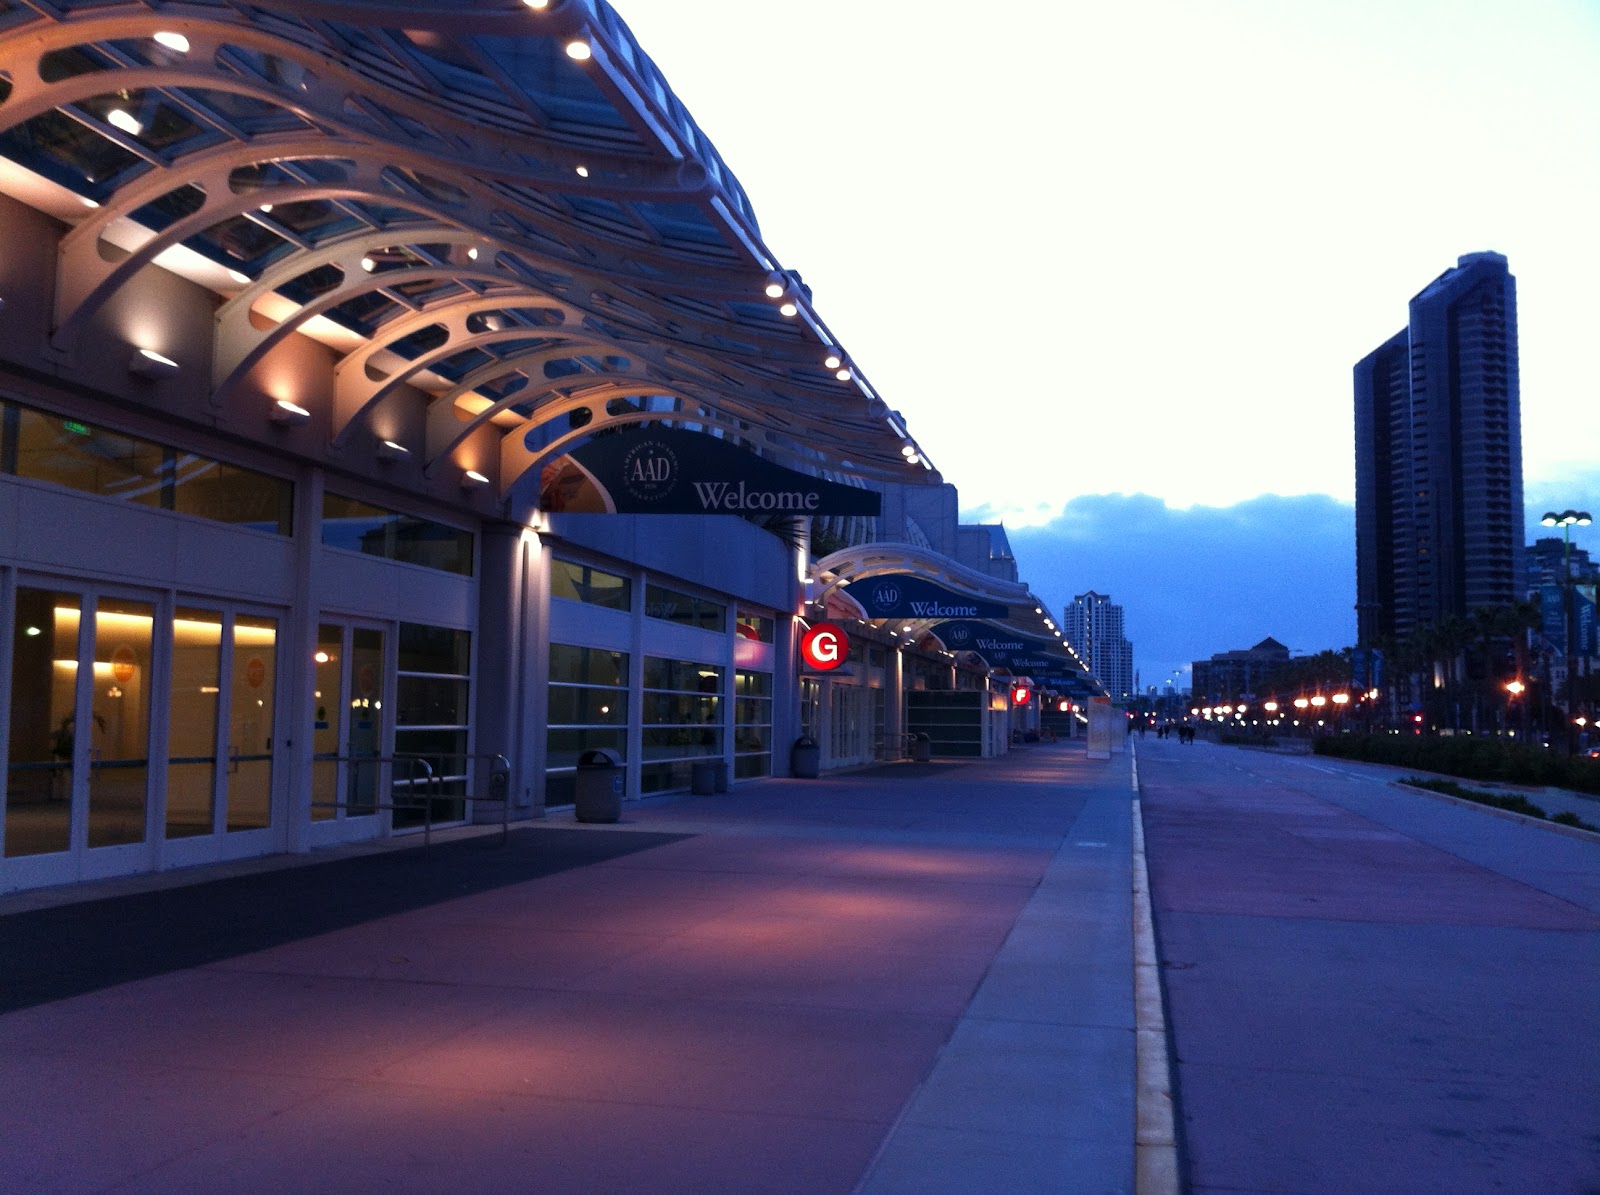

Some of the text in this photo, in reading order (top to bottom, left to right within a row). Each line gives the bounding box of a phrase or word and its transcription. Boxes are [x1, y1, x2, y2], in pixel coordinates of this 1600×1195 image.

[631, 457, 670, 481] AAD
[694, 480, 820, 510] Welcome
[875, 589, 898, 603] AAD
[909, 601, 977, 616] Welcome
[1580, 603, 1592, 651] Welcome
[952, 630, 968, 640] AAD
[811, 631, 838, 662] G
[975, 638, 1024, 650] Welcome
[1012, 658, 1049, 667] Welcome
[1015, 689, 1027, 702] F
